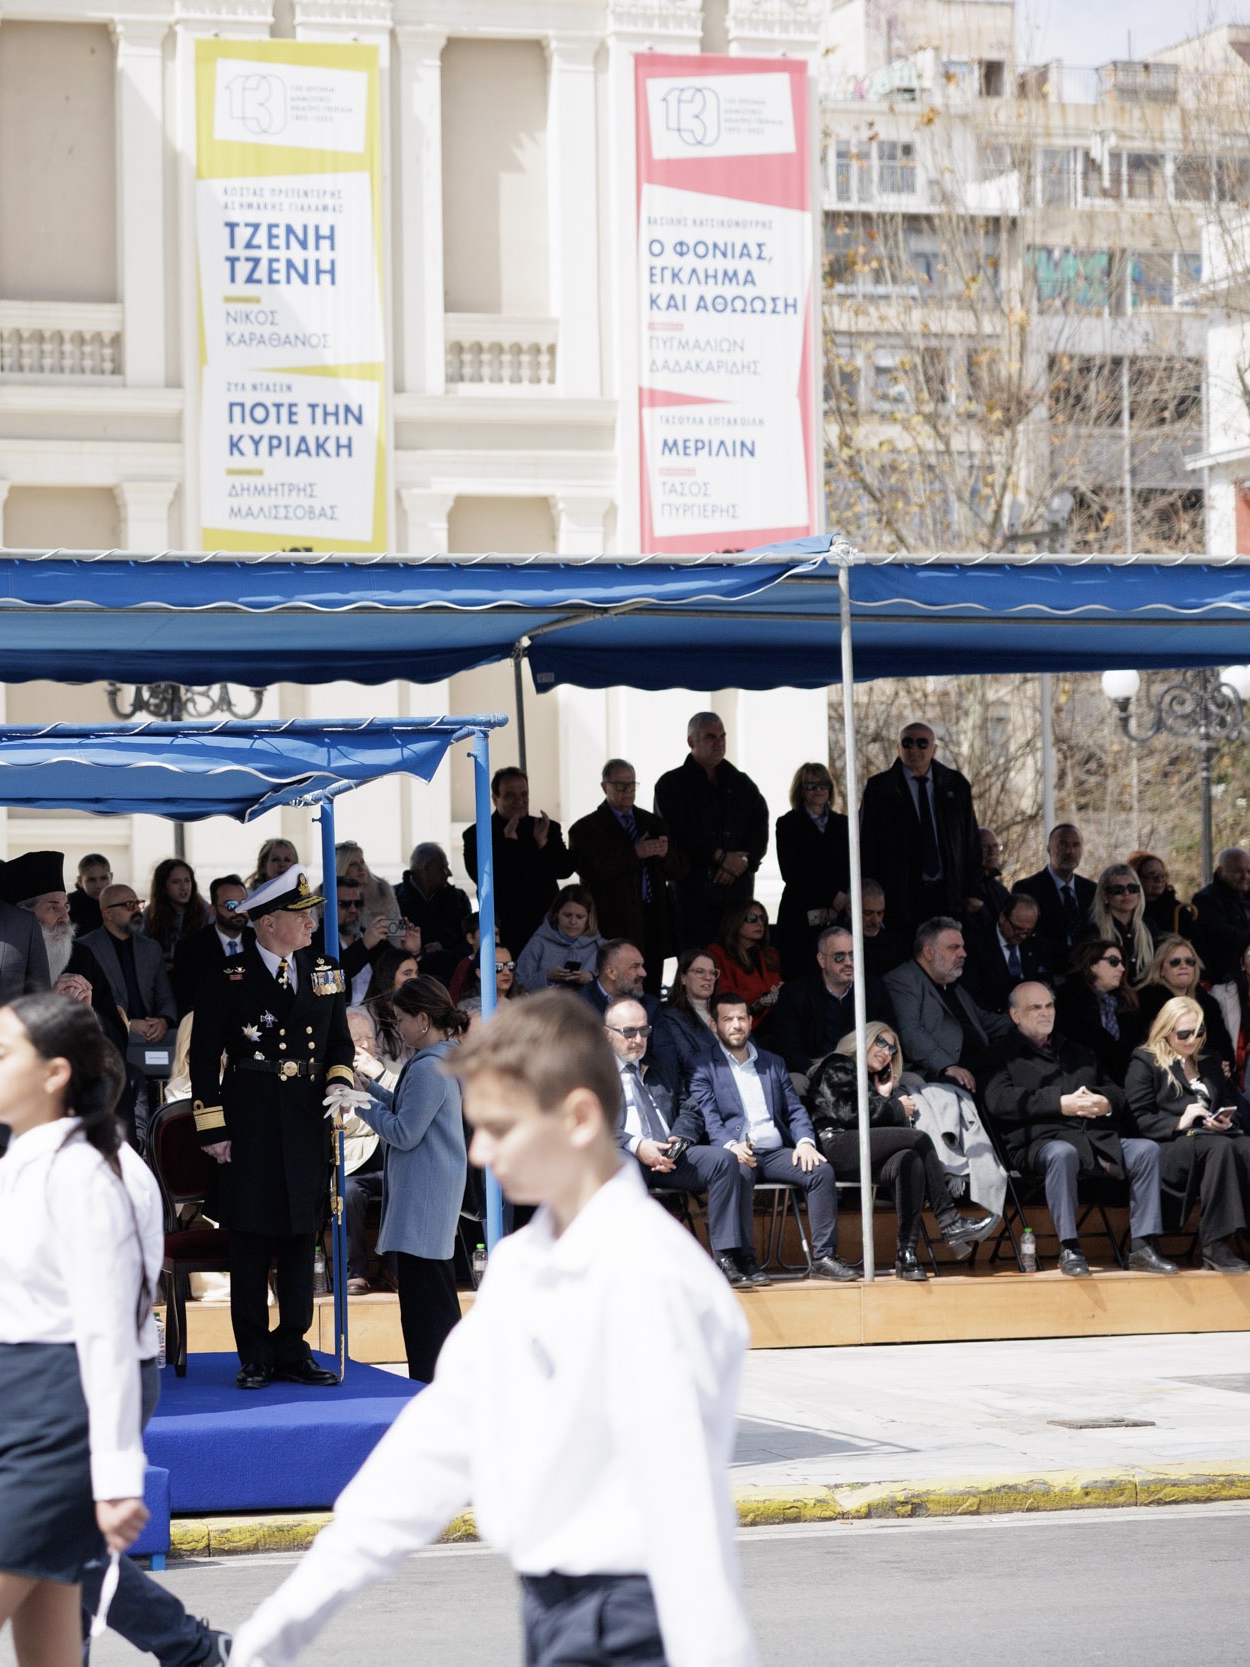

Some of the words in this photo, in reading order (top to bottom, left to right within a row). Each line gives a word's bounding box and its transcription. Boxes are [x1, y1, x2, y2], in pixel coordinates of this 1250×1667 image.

[660, 86, 720, 147] 130
[223, 221, 336, 251] ΤΖΕΝΗ
[648, 239, 665, 258] Ο
[673, 240, 773, 263] ΦΟΝΙΑΣ,
[224, 256, 337, 286] ΤΖΕΝΗ
[649, 266, 757, 287] ΕΓΚΛΗΜΑ
[649, 293, 687, 312] ΚΑΙ
[696, 294, 798, 315] ΑΘΩΩΣΗ
[225, 310, 279, 326] ΝΙΚΟΣ
[225, 331, 332, 349] ΚΑΡΑΘΑΝΟΣ
[648, 336, 745, 353] ΠΥΓΜΑΛΙΩΝ
[648, 359, 761, 375] ΔΑΔΑΚΑΡΙΔΗΣ
[228, 402, 299, 425] ΠΟΤΕ
[307, 402, 364, 426] ΤΗΝ
[228, 434, 354, 458] ΚΥΡΙΑΚΗ
[661, 438, 756, 458] ΜΕΡΙΛΙΝ
[227, 483, 318, 499] ΔΗΜΗΤΡΗΣ
[661, 482, 711, 497] ΤΑΣΟΣ
[228, 504, 339, 521] ΜΑΛΙΣΣΟΒΑΣ
[660, 503, 740, 520] ΠΥΡΓΙΕΡΗΣ
